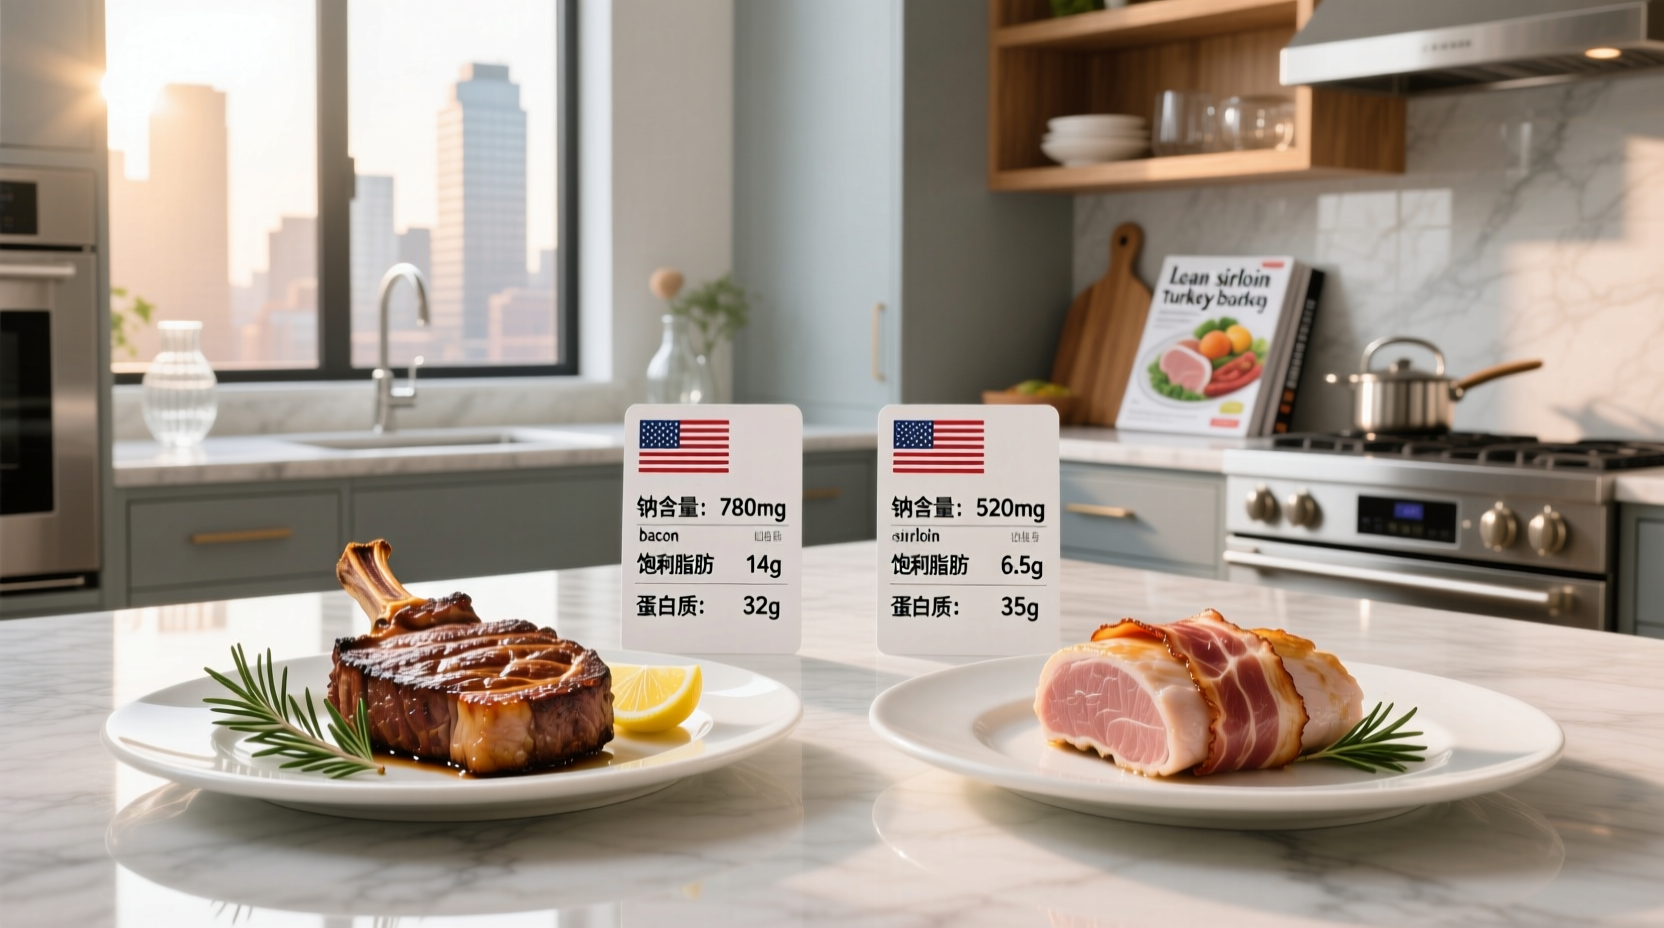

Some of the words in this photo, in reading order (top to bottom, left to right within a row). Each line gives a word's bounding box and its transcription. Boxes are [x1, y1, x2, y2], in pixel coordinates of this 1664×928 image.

[1169, 264, 1210, 286] Lean
[1215, 267, 1271, 288] sirloin
[720, 497, 786, 523] 780mg
[977, 498, 1046, 524] 520mg
[639, 527, 680, 542] bacon
[747, 555, 782, 579] 14g
[891, 553, 969, 576] 饱利脂肪
[1001, 555, 1044, 581] 6.5g
[743, 595, 781, 621] 32g
[1001, 596, 1039, 623] 35g
